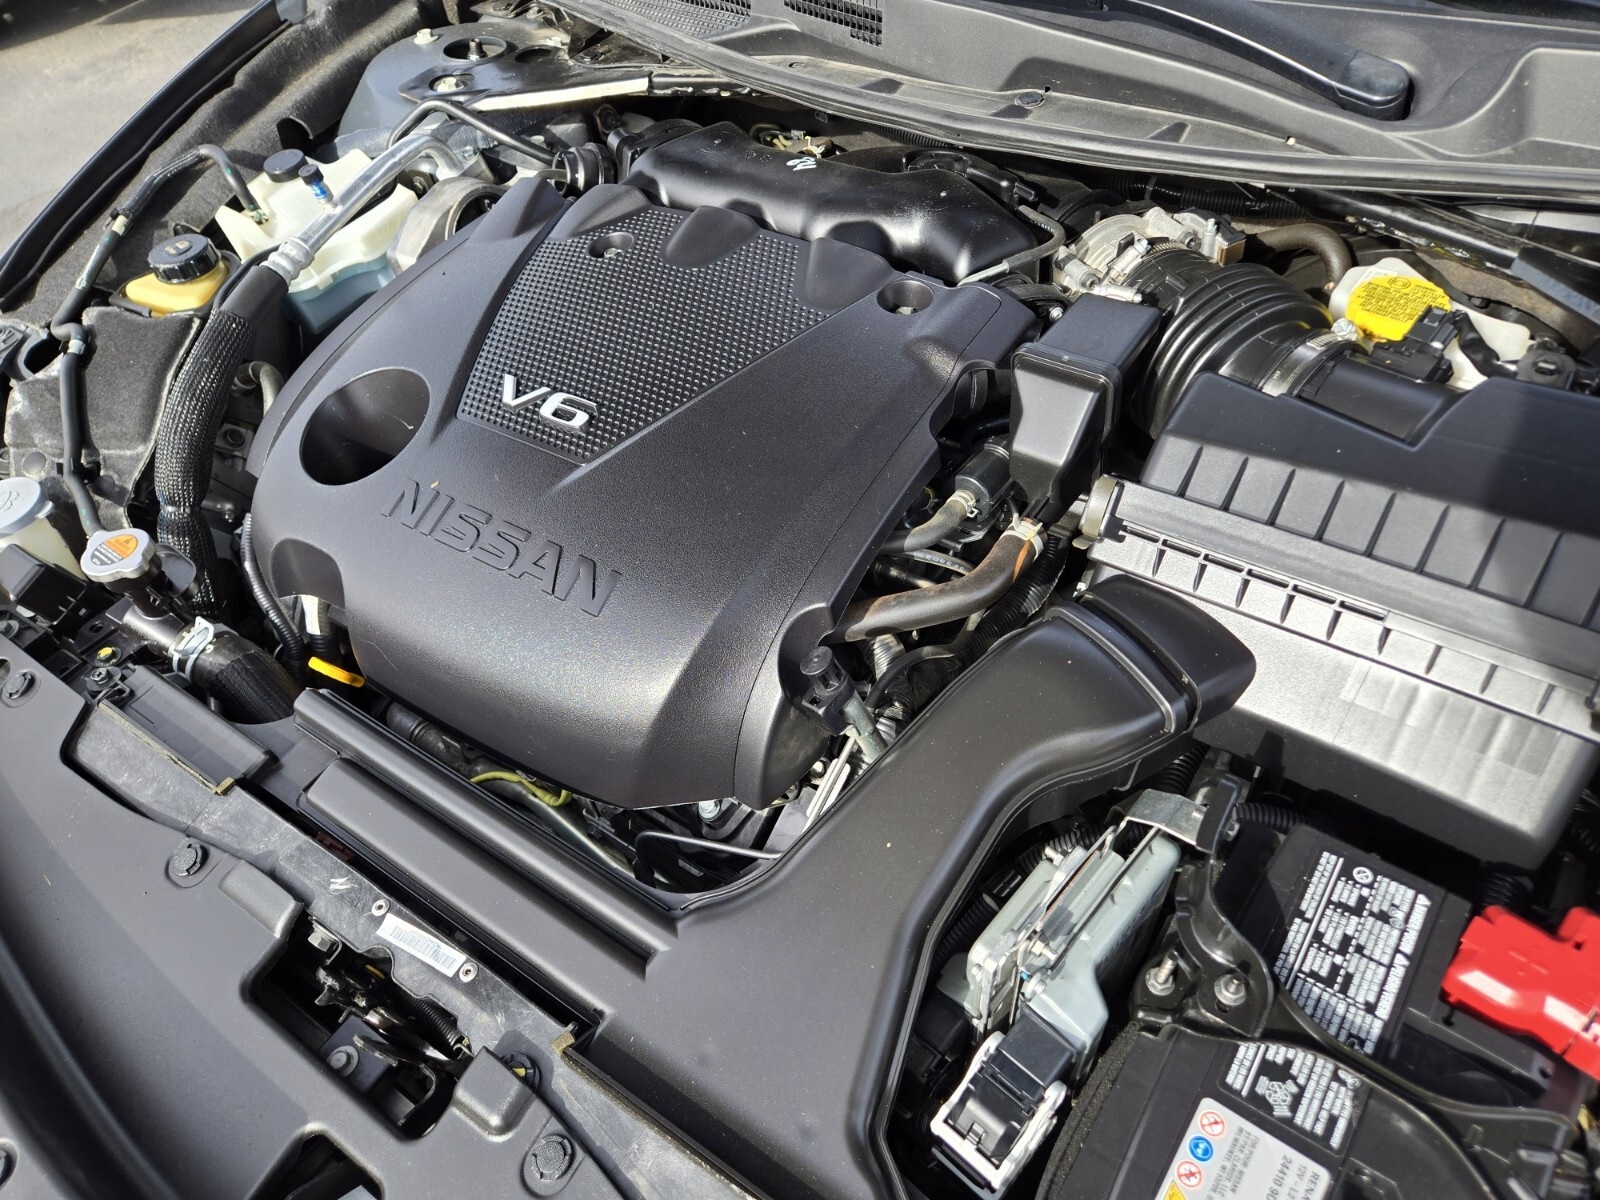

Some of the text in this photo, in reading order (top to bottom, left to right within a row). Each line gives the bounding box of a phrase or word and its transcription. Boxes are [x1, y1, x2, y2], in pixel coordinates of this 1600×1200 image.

[501, 373, 598, 434] V6
[380, 477, 623, 618] NISSAN
[1229, 1168, 1244, 1193] NISSAN
[1272, 1154, 1293, 1187] 24410
[1294, 1163, 1307, 1180] 12V
